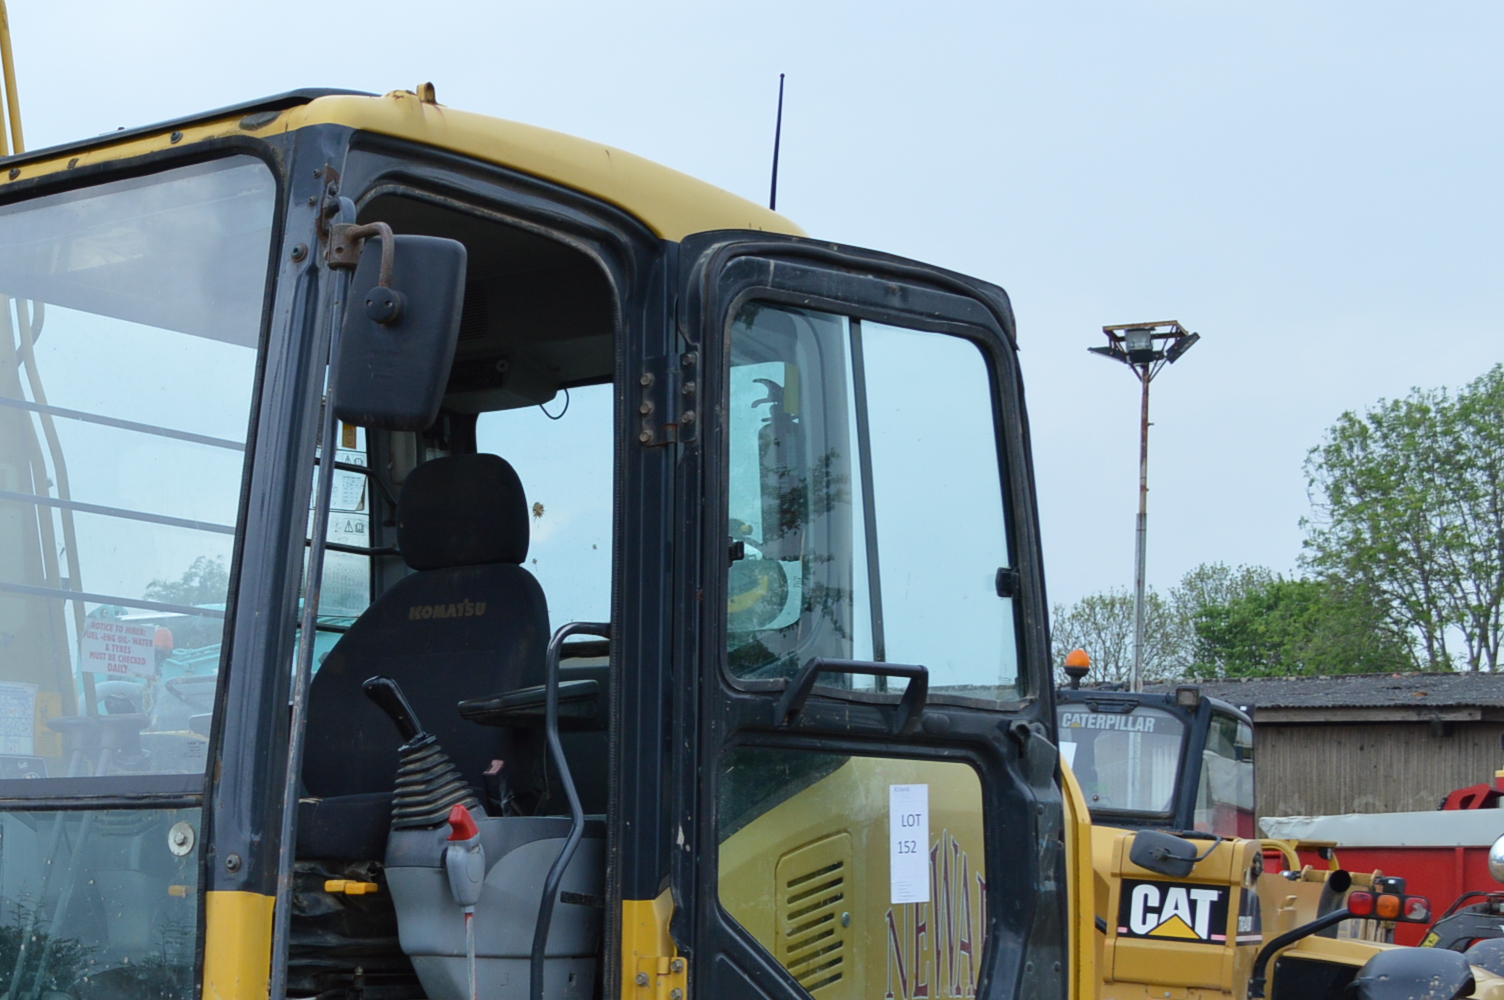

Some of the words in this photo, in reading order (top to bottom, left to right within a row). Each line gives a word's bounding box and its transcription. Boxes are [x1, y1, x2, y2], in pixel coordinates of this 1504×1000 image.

[408, 599, 487, 621] KOMATSU
[91, 622, 114, 632] NOTICE
[116, 624, 124, 633] TO
[125, 626, 146, 636] HIRER:
[132, 637, 153, 647] WATER
[112, 645, 131, 654] TYRES
[89, 650, 107, 660] MUST
[108, 653, 117, 662] BE
[118, 655, 147, 665] CHECKED
[107, 663, 128, 673] DAILY
[1062, 713, 1155, 732] CATERPILLAR
[901, 813, 922, 828] LOT
[898, 840, 917, 854] 152
[1129, 883, 1220, 941] CAT
